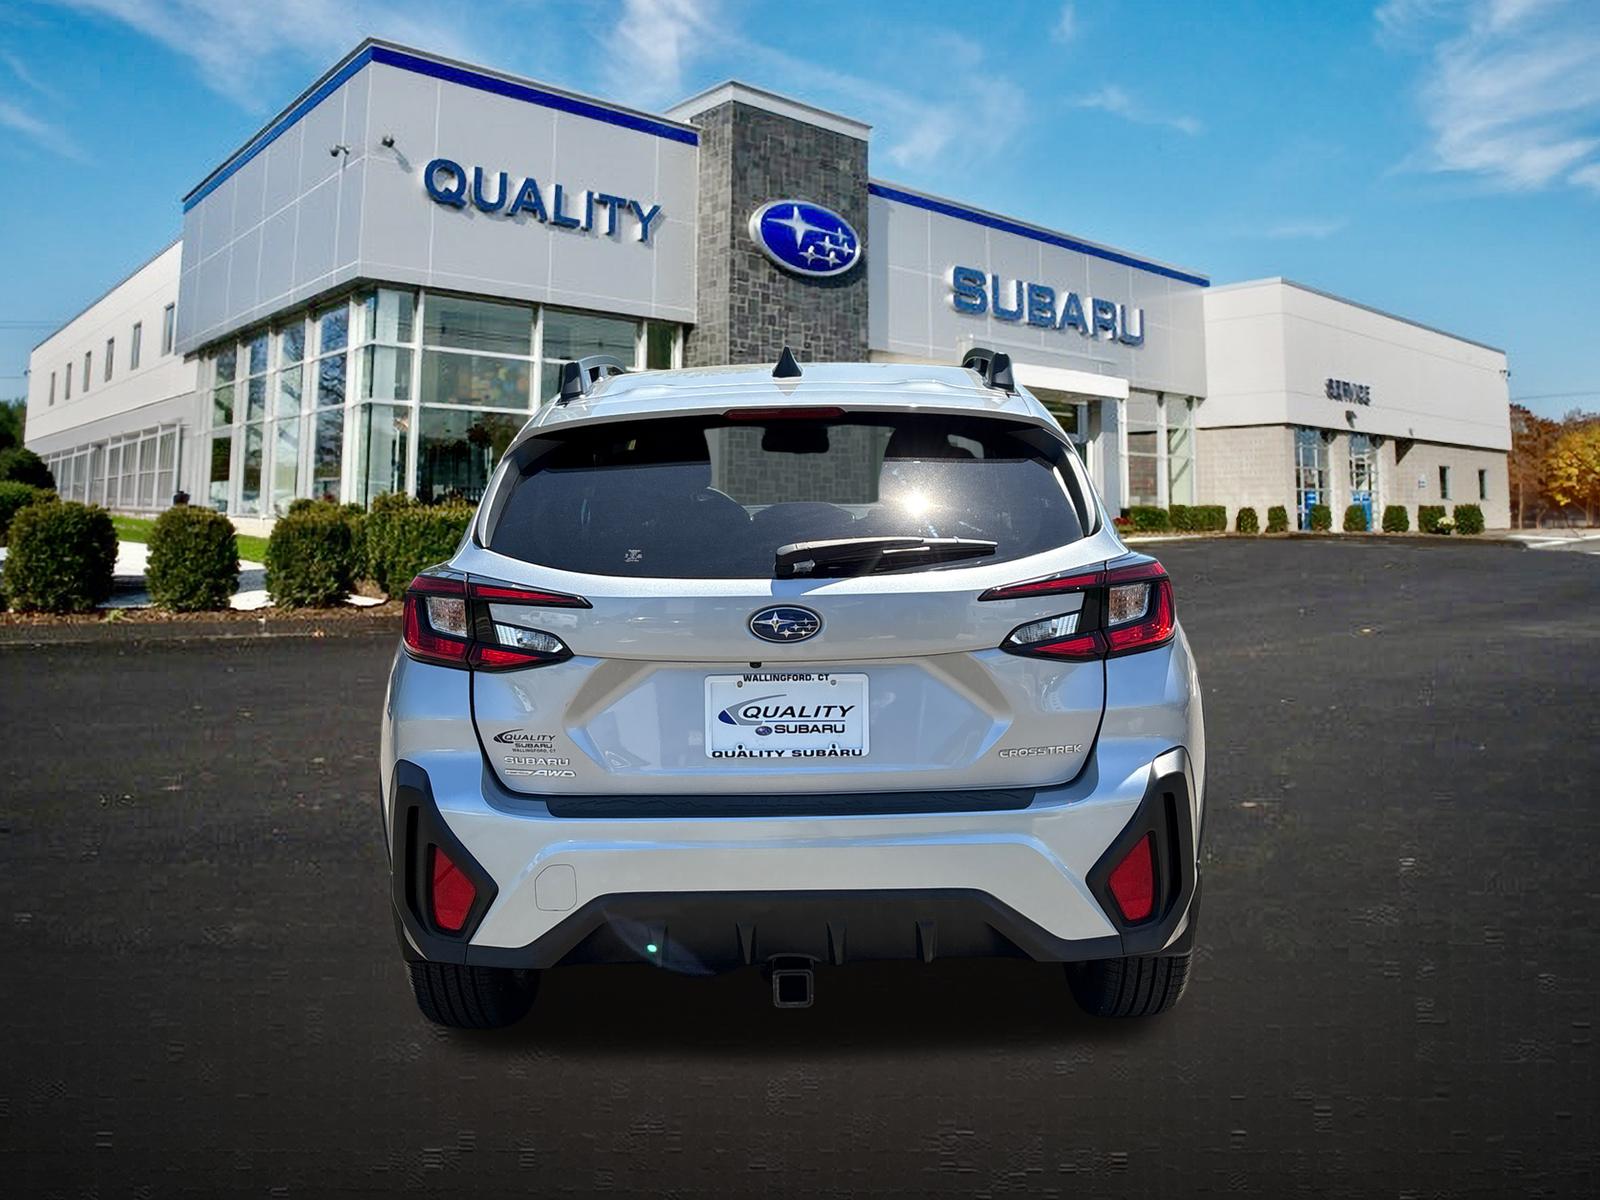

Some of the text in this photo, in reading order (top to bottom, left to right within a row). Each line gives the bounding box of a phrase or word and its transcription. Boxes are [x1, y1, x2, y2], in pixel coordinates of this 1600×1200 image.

[424, 158, 661, 242] QUALITY
[946, 265, 1145, 346] SUBARU
[1325, 378, 1371, 406] SERVICE
[818, 673, 830, 681] CT
[742, 705, 855, 719] QUALITY
[774, 724, 846, 734] SUBARU
[711, 749, 863, 758] QUALITY SUBARU
[999, 744, 1083, 758] CROSSTREK
[504, 756, 569, 766] SUBARU
[532, 769, 577, 778] AWD
